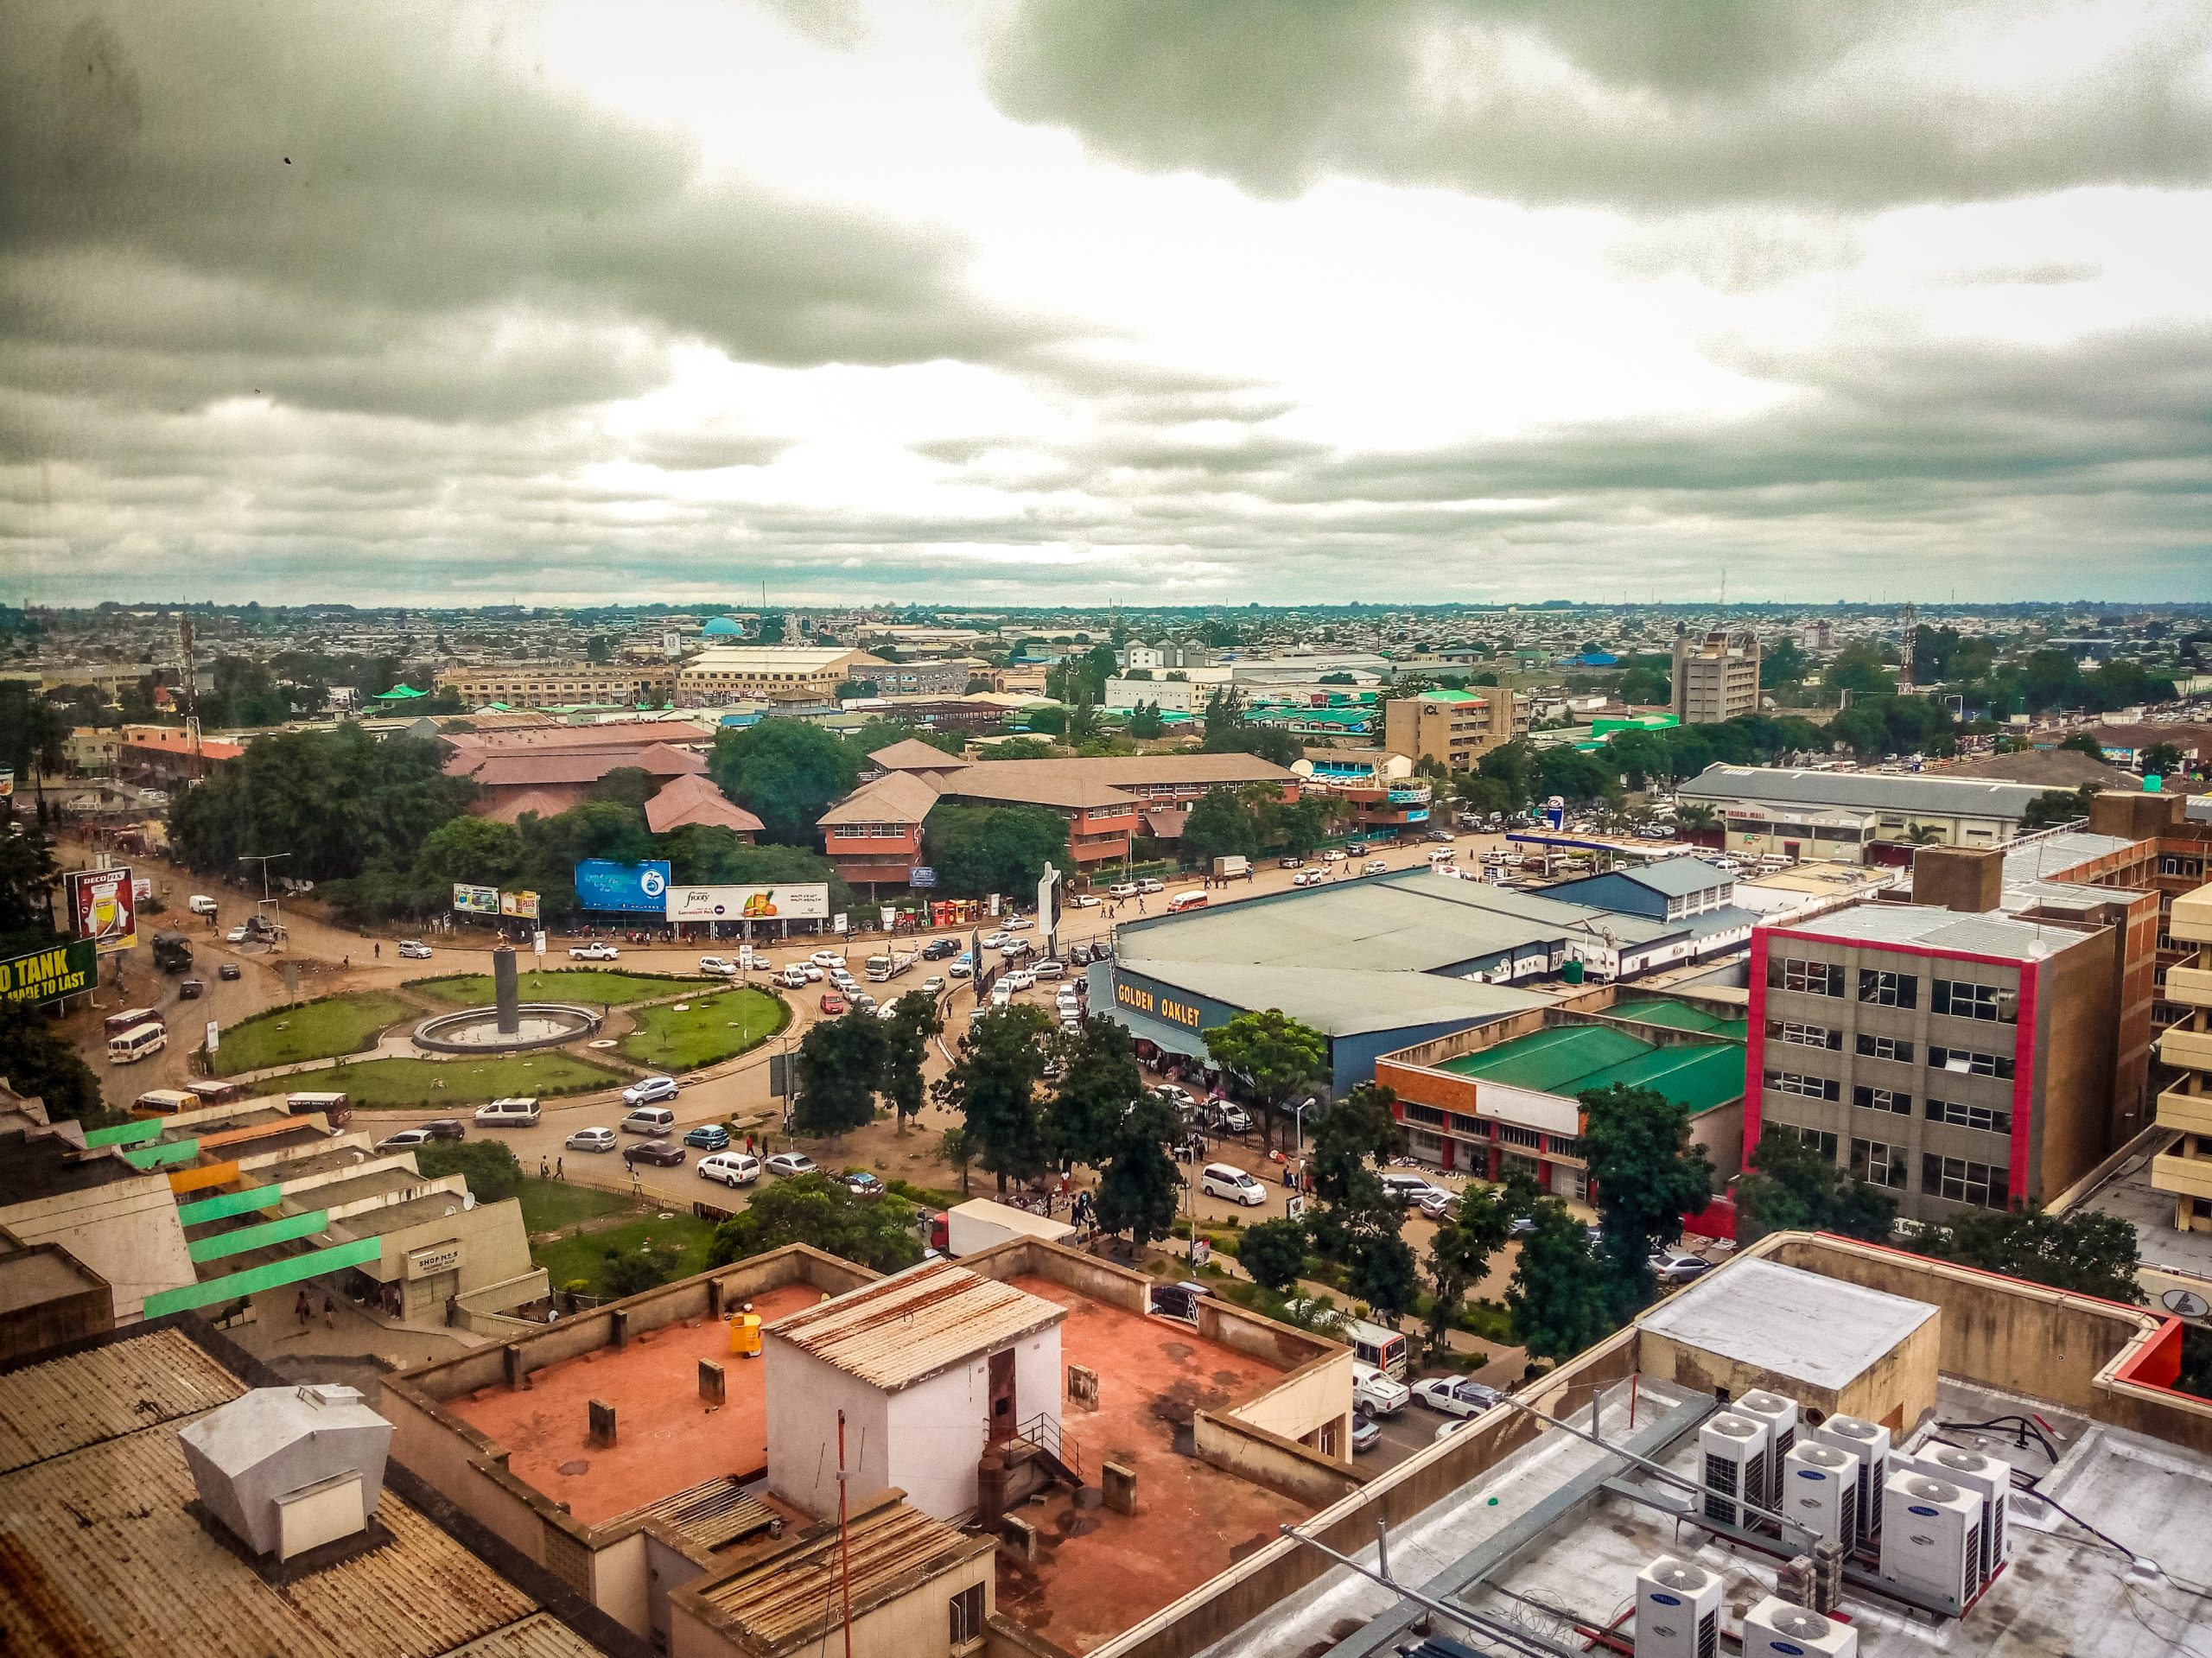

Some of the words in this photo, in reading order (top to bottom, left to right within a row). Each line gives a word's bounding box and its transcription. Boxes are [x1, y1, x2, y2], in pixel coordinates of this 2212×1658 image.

[84, 876, 106, 885] DECO
[108, 873, 123, 881] FIX
[523, 899, 536, 908] PLUS
[15, 949, 69, 987] TANK
[41, 979, 56, 996] TO
[58, 970, 85, 992] LAST
[1118, 983, 1154, 1012] GOLDEN
[1160, 998, 1199, 1027] OAKLET
[419, 1256, 440, 1267] SHOP
